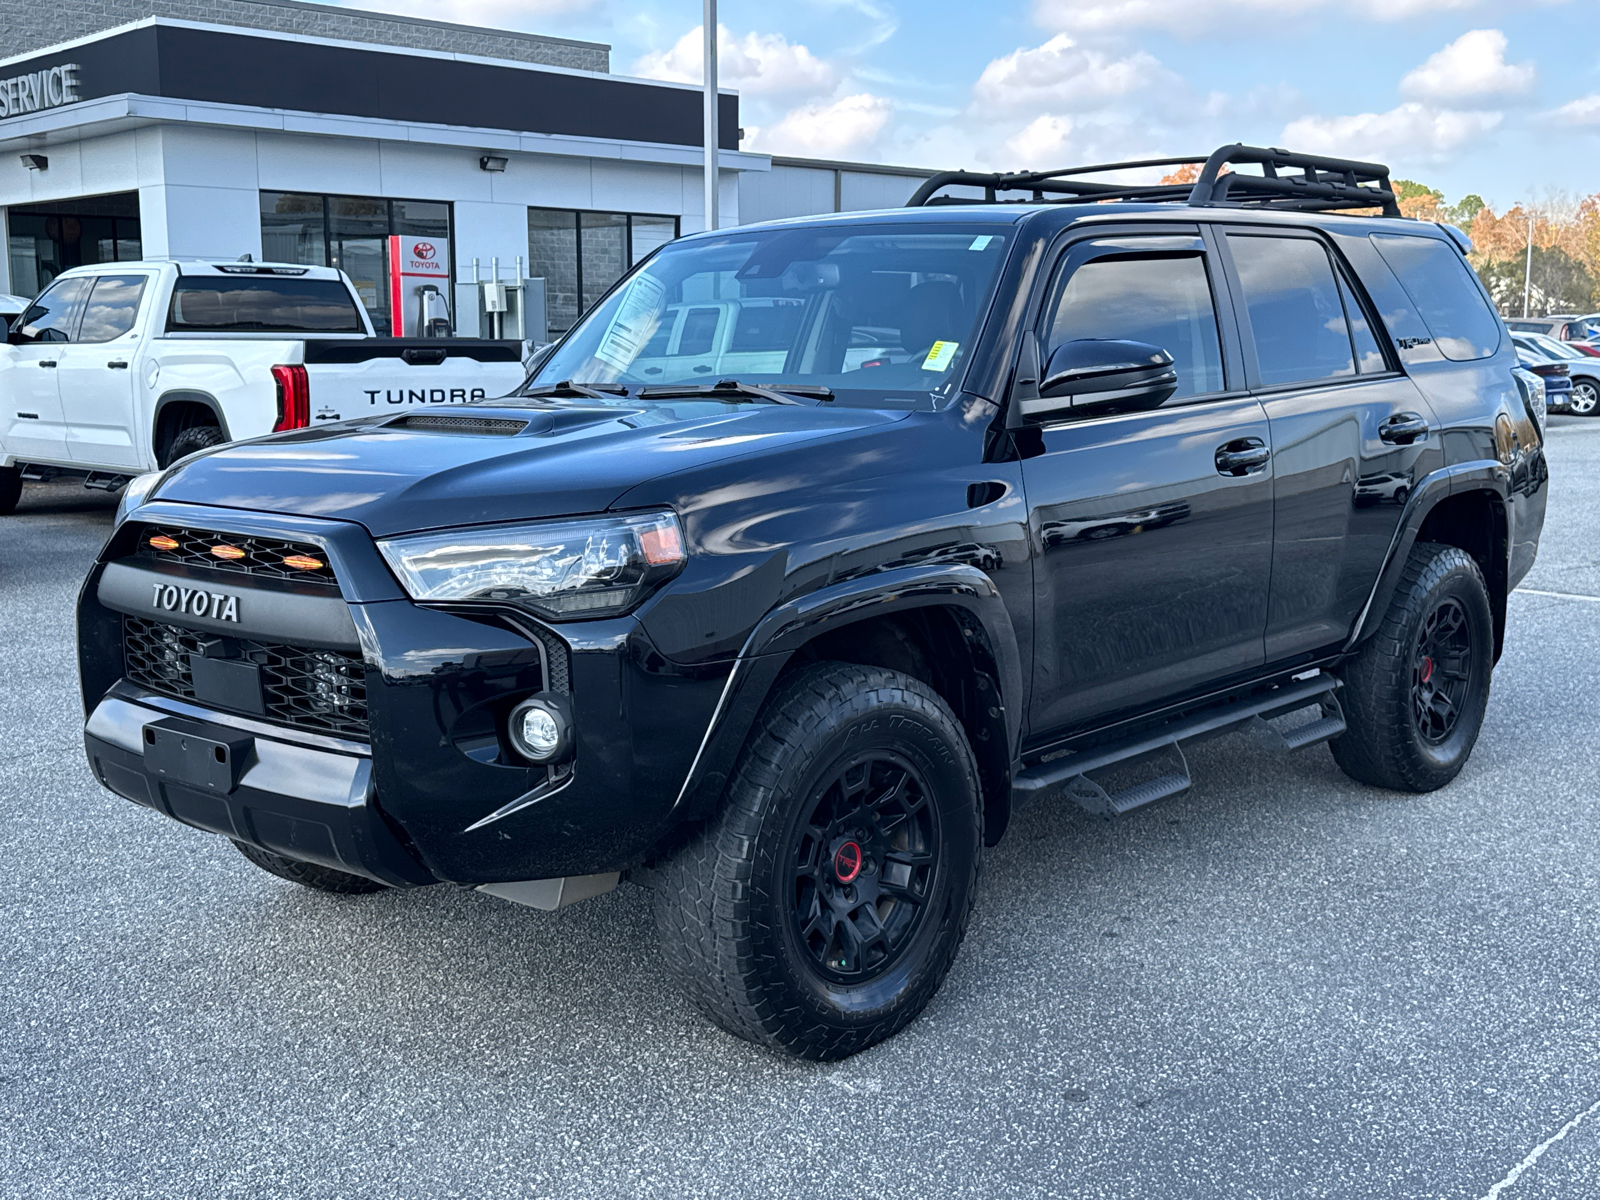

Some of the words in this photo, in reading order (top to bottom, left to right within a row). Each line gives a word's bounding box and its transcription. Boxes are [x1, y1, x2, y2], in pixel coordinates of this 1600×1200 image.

[0, 63, 80, 118] SERVICE
[410, 261, 440, 269] TOYOTA
[363, 388, 486, 405] TUNDRA
[152, 583, 240, 623] TOYOTA
